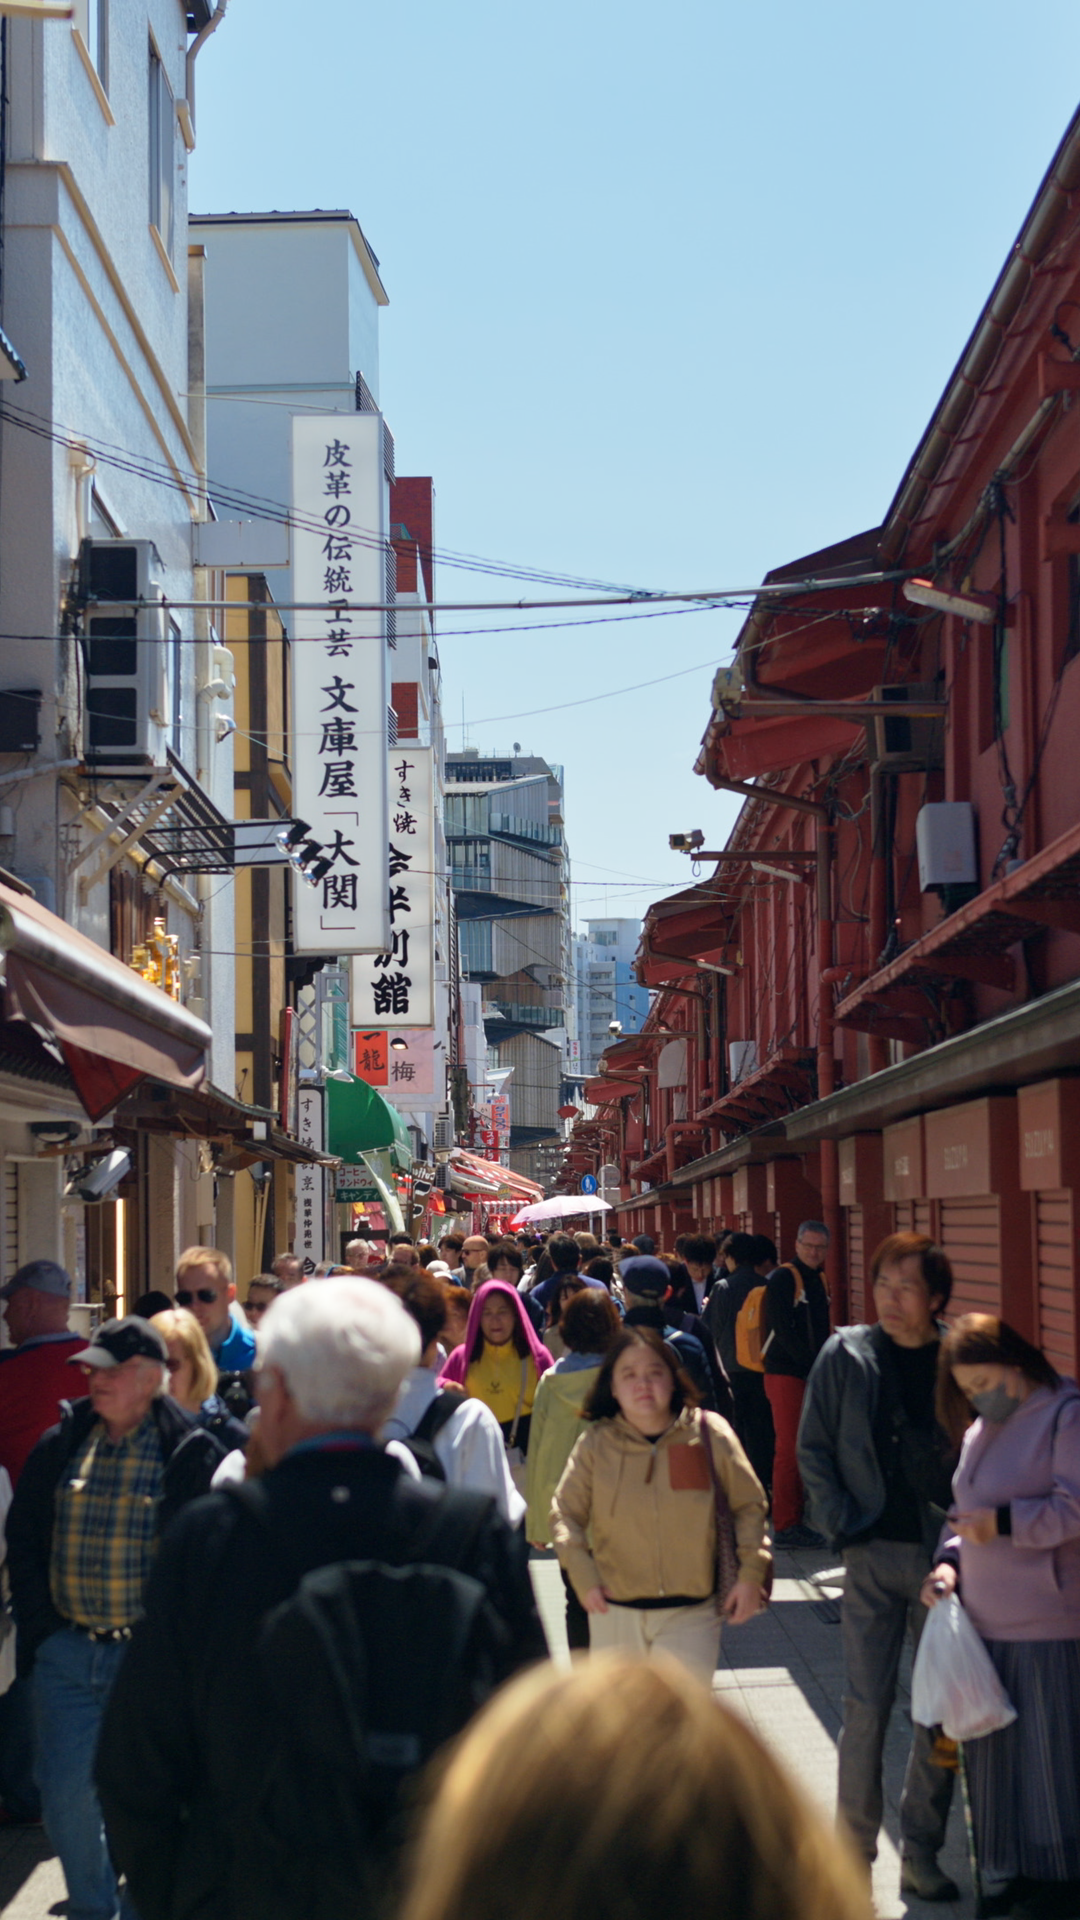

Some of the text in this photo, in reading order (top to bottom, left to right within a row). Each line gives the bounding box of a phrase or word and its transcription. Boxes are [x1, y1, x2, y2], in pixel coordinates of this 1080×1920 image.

[318, 438, 361, 930] 皮革の伝統工芸 文庫屋「大関」
[393, 759, 417, 834] すき焼
[339, 1168, 367, 1177] コーヒー
